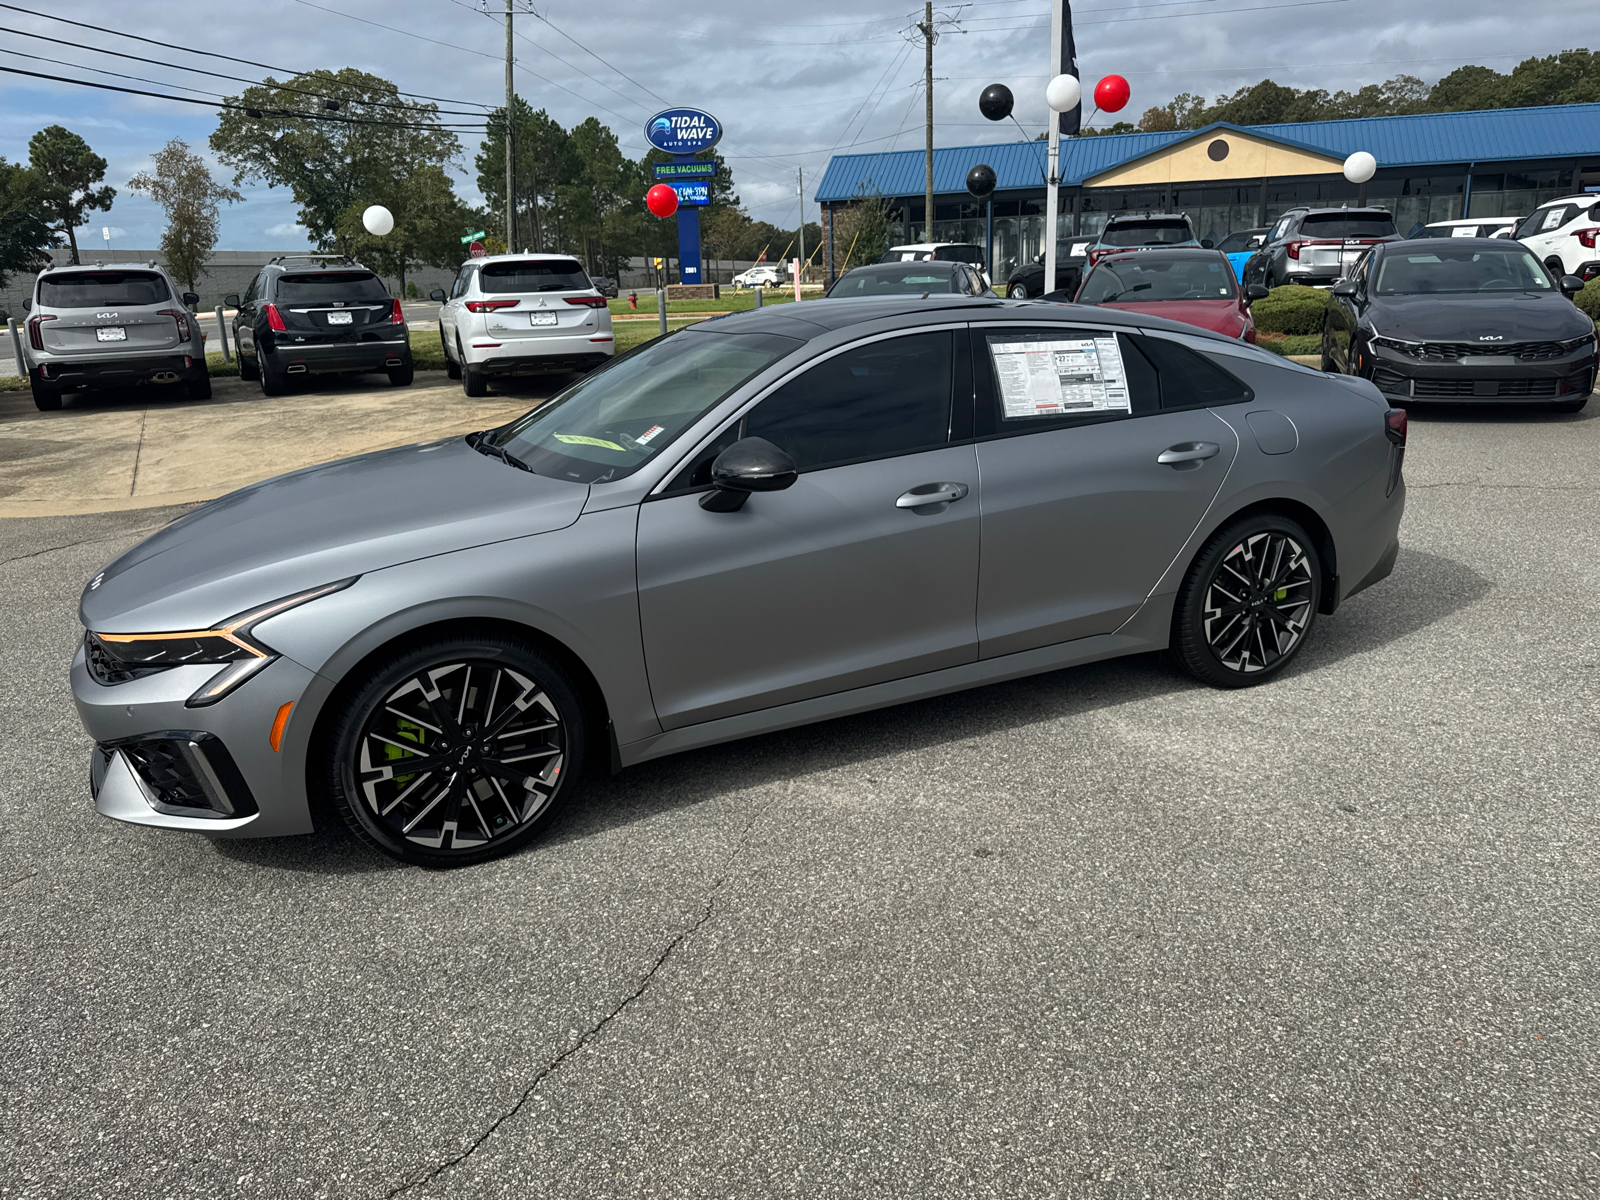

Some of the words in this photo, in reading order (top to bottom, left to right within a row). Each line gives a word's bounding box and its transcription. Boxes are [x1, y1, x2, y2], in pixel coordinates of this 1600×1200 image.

[671, 116, 706, 128] TIDAL
[677, 127, 713, 140] WAVE
[656, 166, 676, 175] FREE
[676, 163, 713, 174] VACUUMS
[471, 249, 486, 258] STOP
